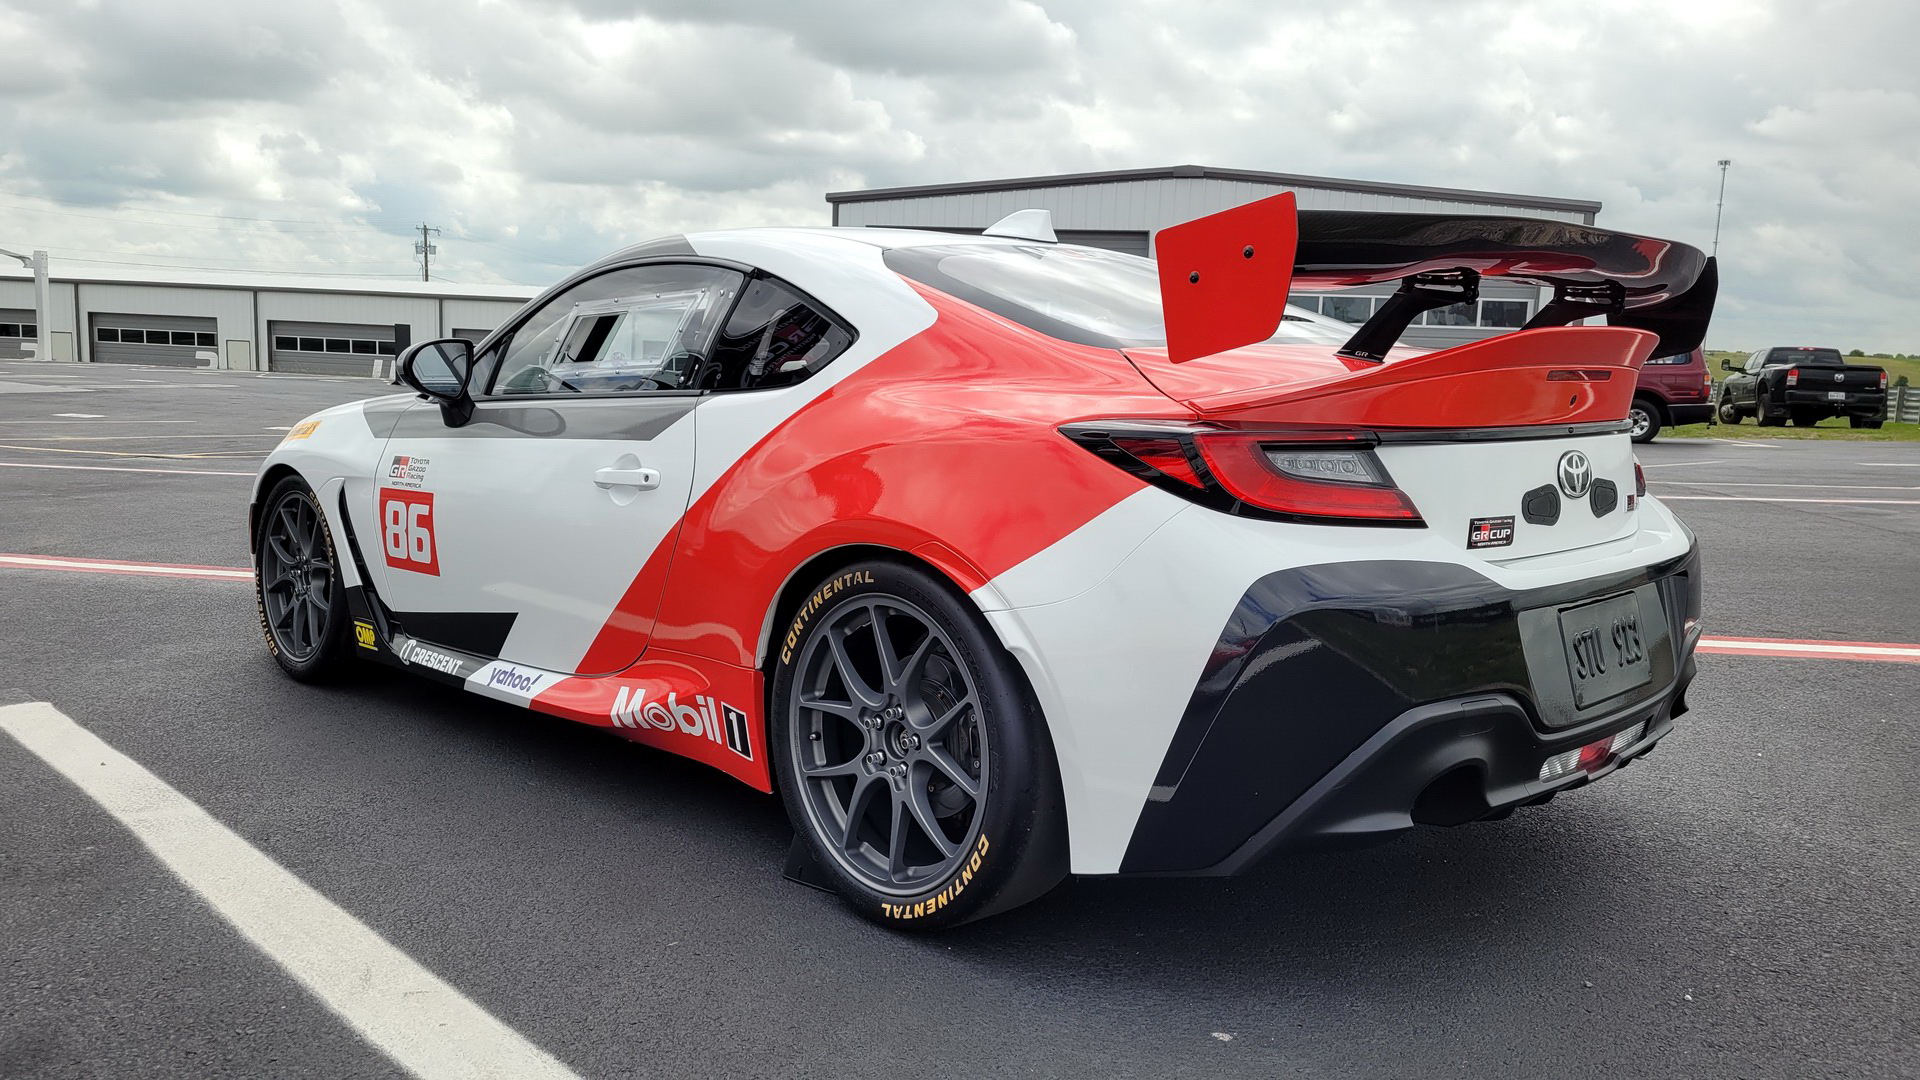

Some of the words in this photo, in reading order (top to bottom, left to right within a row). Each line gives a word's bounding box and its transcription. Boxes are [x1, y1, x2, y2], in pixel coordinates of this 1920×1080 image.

[1354, 350, 1369, 358] GR
[389, 464, 407, 478] GR
[410, 457, 430, 465] TOYOTA
[404, 481, 422, 489] AMERICA
[385, 499, 432, 565] 86
[1473, 531, 1489, 541] GR
[1490, 529, 1511, 539] CUP
[781, 570, 875, 666] CONTINENTAL
[355, 625, 376, 646] OMP
[410, 646, 464, 676] CRESCENT
[1572, 626, 1607, 680] STU
[487, 666, 543, 693] yahoo!
[610, 686, 723, 745] Mobil
[881, 833, 990, 920] CONTINENTAL
